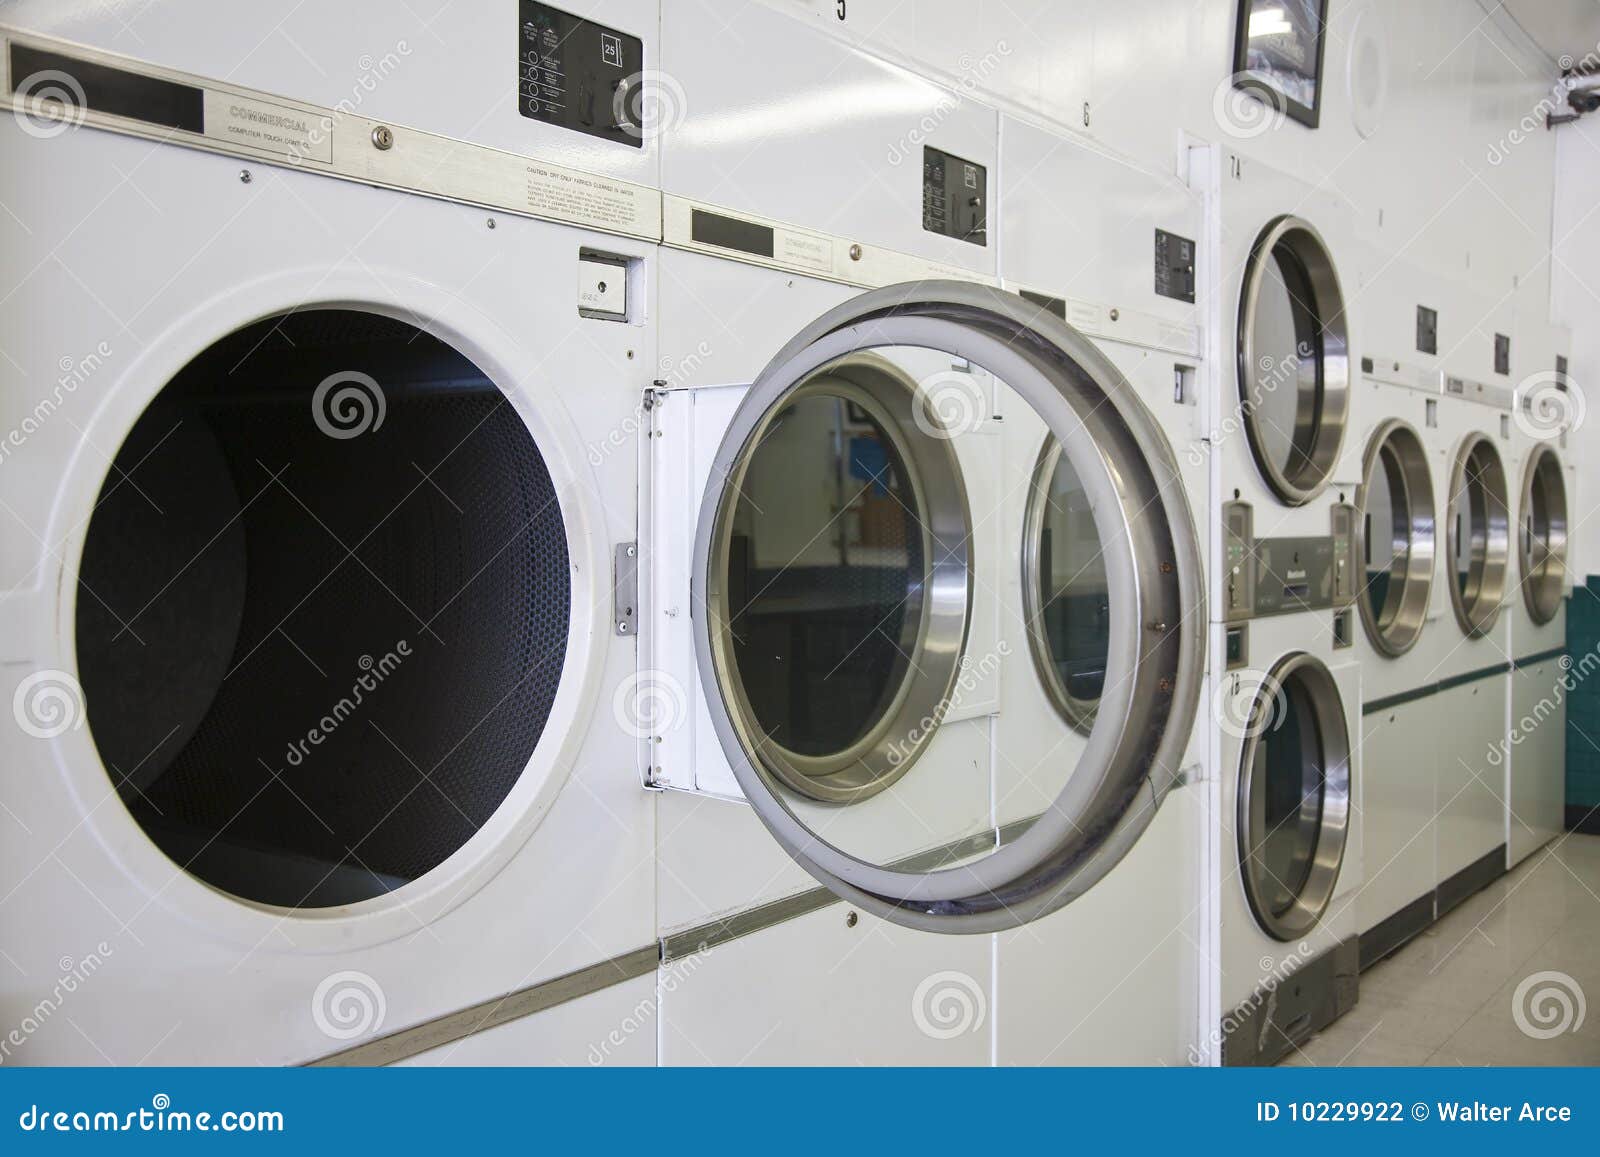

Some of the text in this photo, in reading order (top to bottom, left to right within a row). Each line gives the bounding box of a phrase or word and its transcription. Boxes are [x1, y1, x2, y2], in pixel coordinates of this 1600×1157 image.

[837, 0, 846, 21] 5
[604, 44, 616, 56] 25
[229, 105, 308, 132] COMMERCIAL
[1083, 101, 1090, 128] 6
